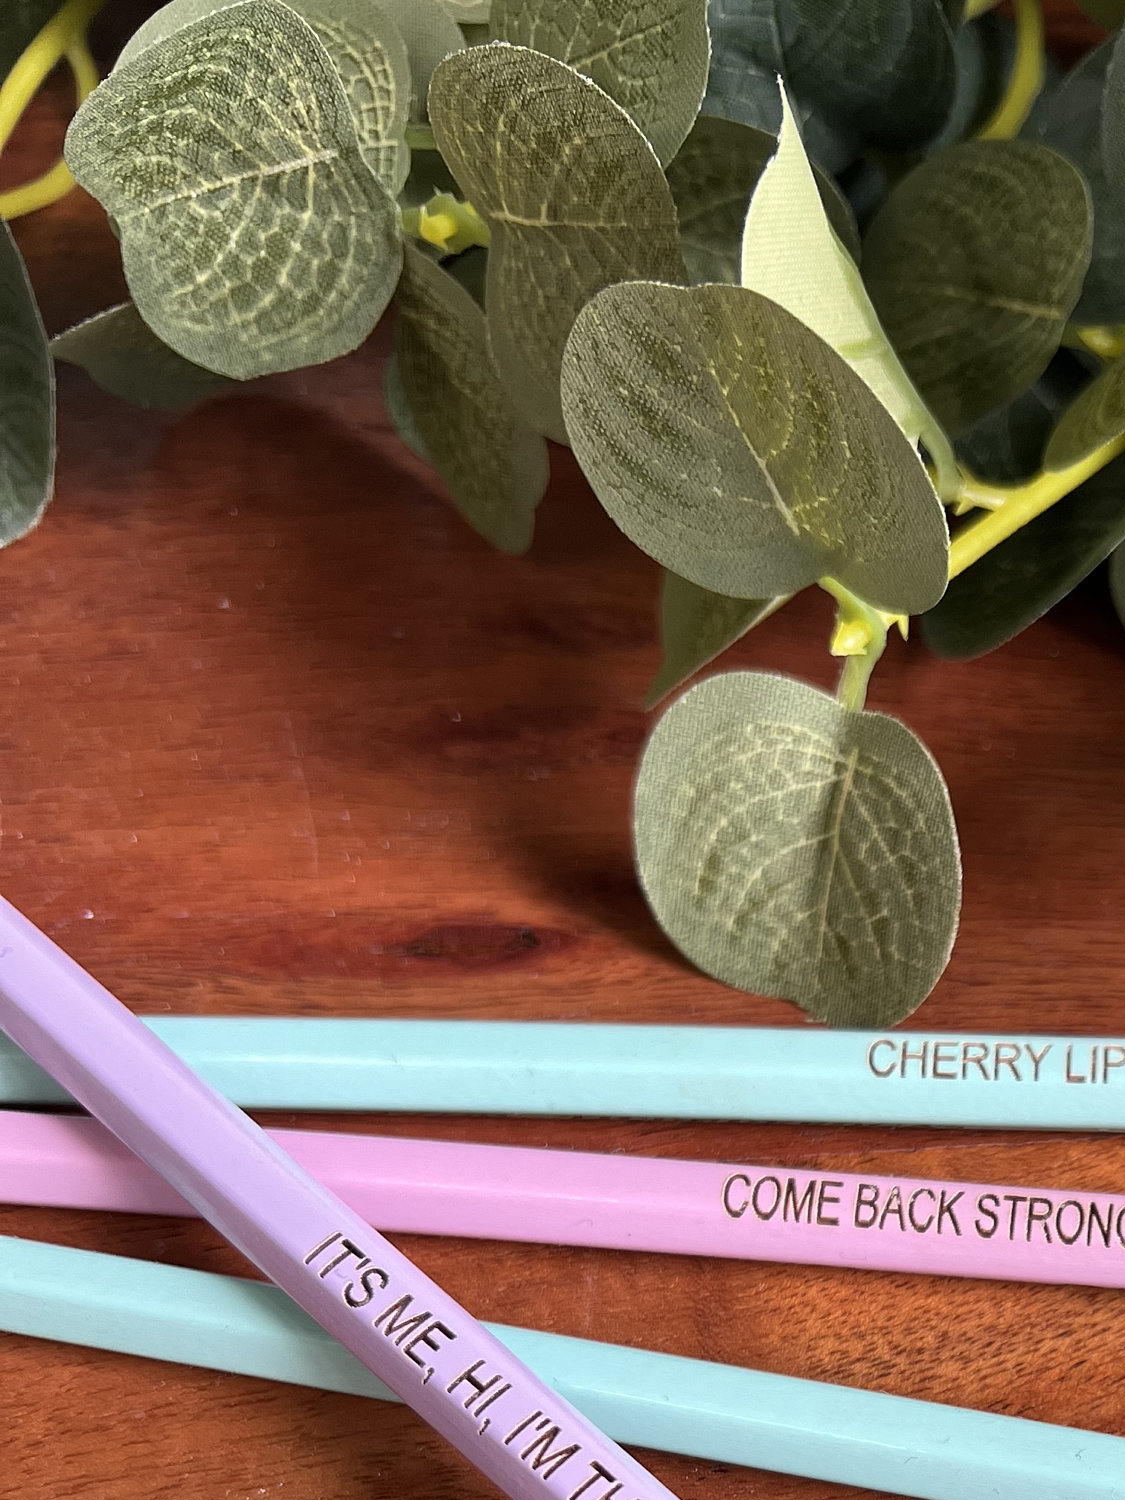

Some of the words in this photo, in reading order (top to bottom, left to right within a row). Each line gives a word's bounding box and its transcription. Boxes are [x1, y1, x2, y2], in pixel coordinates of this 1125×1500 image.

[868, 1039, 1052, 1082] CHERRY
[722, 1173, 844, 1227] COME
[853, 1183, 965, 1236] BACK
[304, 1231, 389, 1308] IT'S
[374, 1293, 458, 1385] ME,
[446, 1359, 513, 1436] HI,
[503, 1410, 583, 1480] I'M
